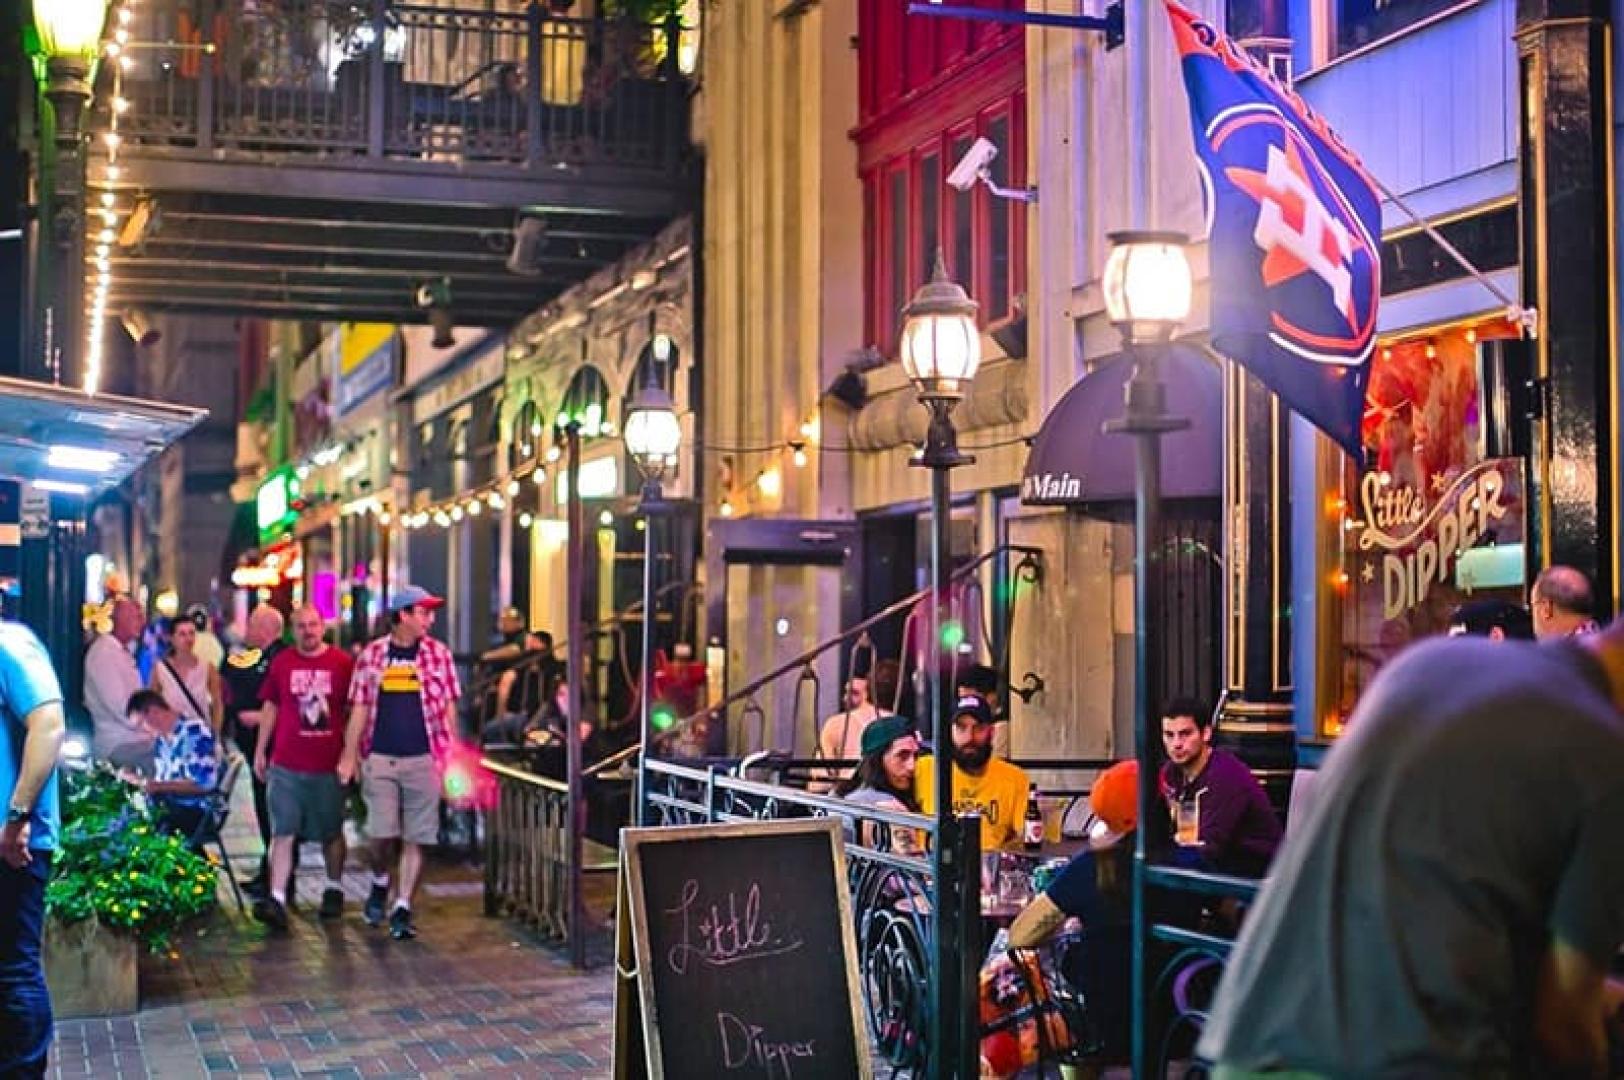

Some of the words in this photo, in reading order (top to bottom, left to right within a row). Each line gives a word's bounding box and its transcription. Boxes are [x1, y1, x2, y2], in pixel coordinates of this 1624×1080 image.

[1031, 472, 1081, 500] Main
[1360, 471, 1426, 550] Little
[1383, 469, 1507, 620] DIPPER
[717, 1011, 816, 1080] Dipper
